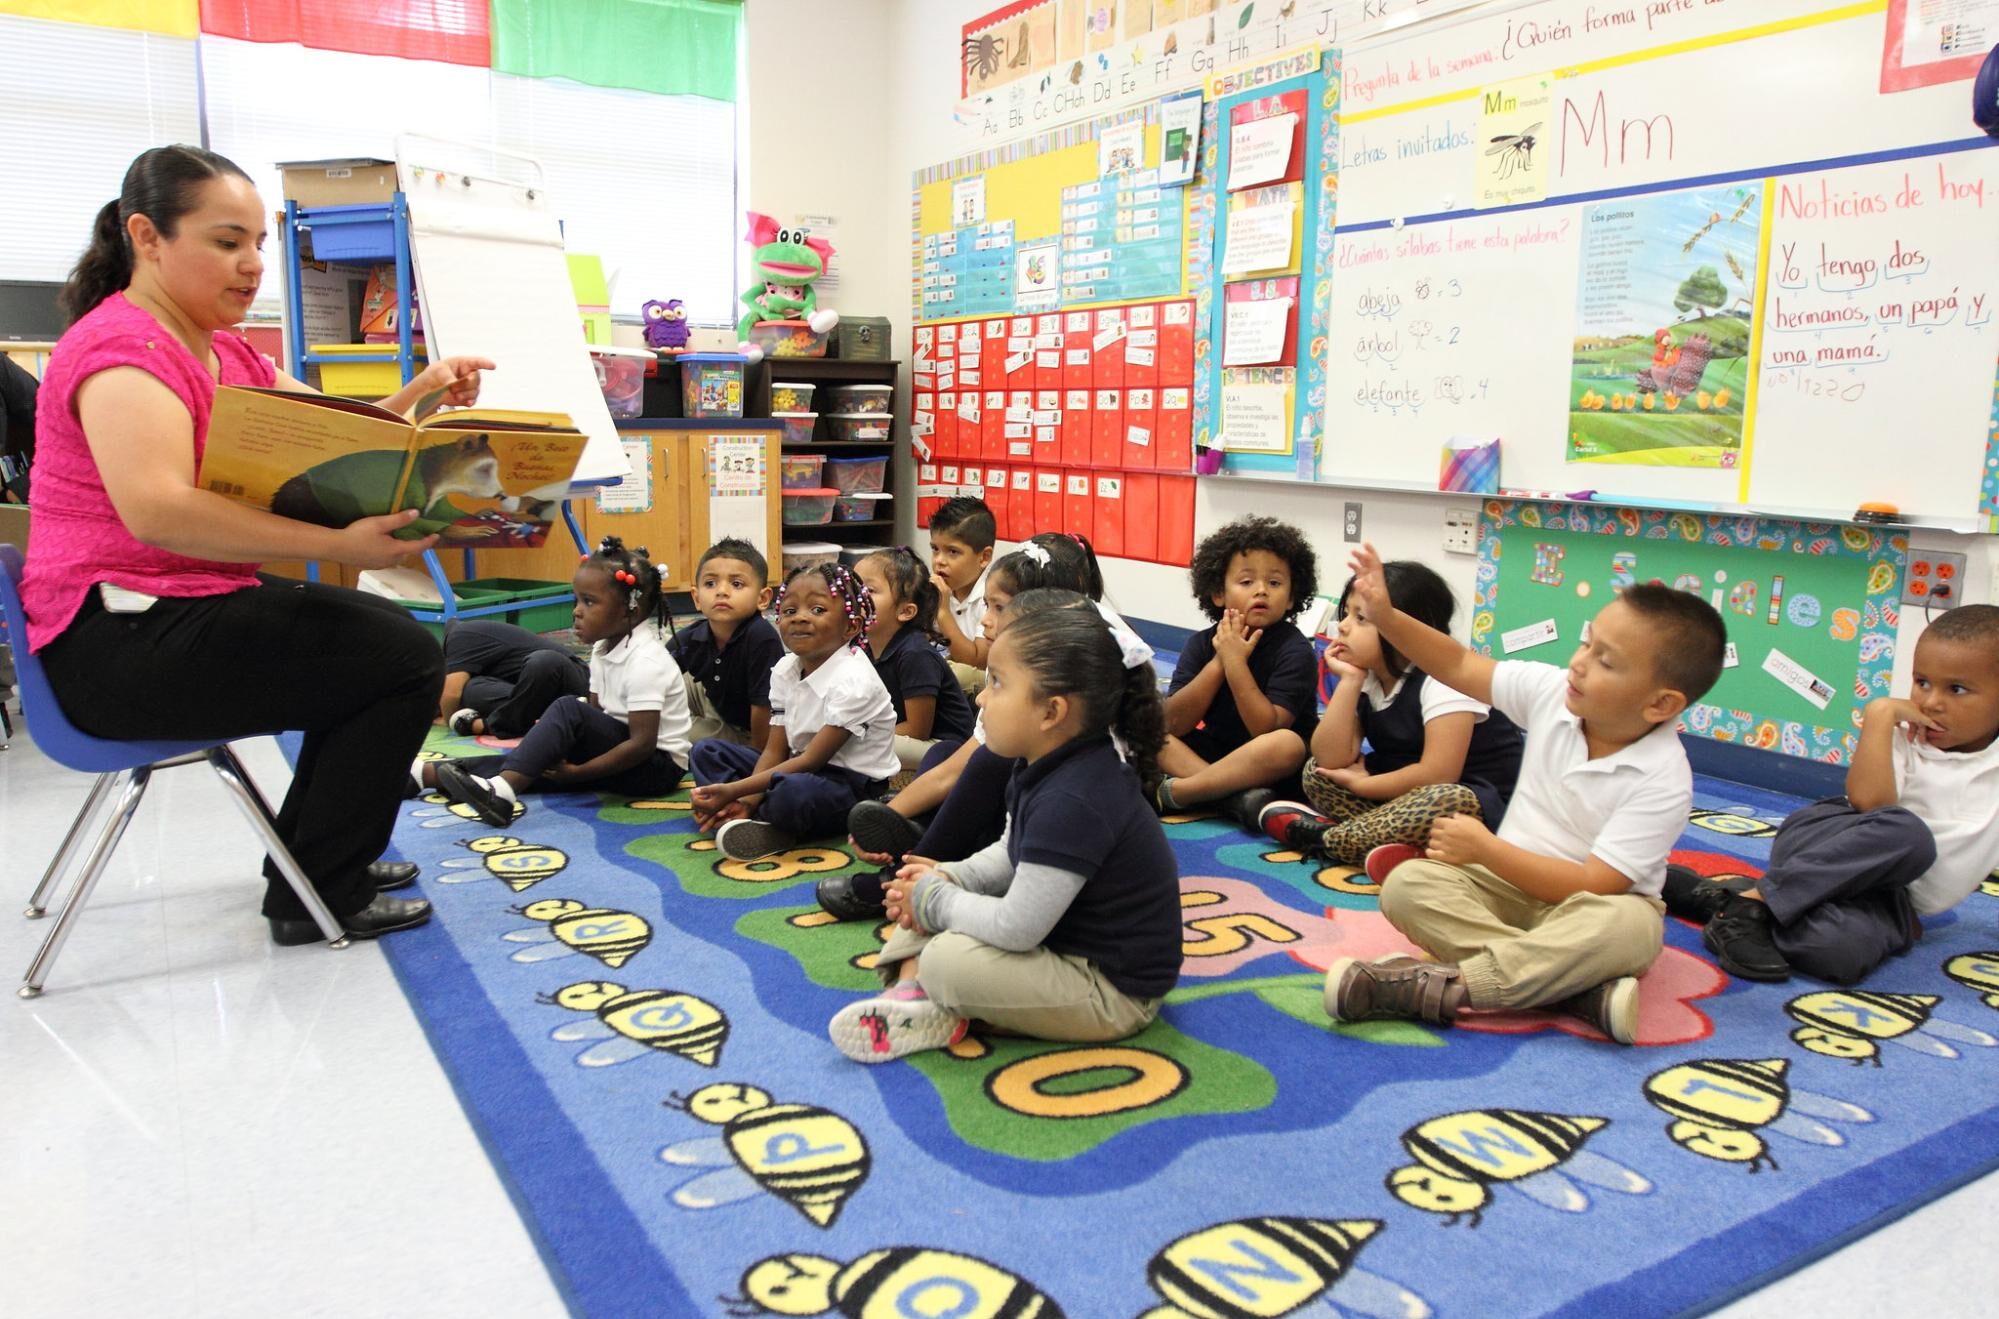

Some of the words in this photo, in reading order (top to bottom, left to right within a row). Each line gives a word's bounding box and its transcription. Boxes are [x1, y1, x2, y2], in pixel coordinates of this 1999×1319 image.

[1584, 6, 1636, 33] forma
[1094, 80, 1111, 103] Dd
[1121, 73, 1136, 94] Ee
[1155, 59, 1172, 83] Ff
[1229, 37, 1248, 62] Hh
[1317, 8, 1337, 44] Jj
[1212, 51, 1314, 96] OBJECTIVES
[1343, 61, 1400, 101] Pregunta
[1408, 60, 1421, 82] de
[1428, 56, 1440, 79] la
[1485, 90, 1517, 115] Mm
[1342, 128, 1388, 169] Letras
[1560, 89, 1674, 177] Mm
[1245, 185, 1289, 208] MATH
[1780, 178, 1888, 219] Noticias
[1896, 173, 1924, 209] de
[1484, 226, 1509, 249] esta
[1782, 241, 1801, 283] Yo
[1817, 242, 1876, 287] tengo
[1889, 239, 1925, 269] dos
[1358, 287, 1401, 314] abeja
[1449, 279, 1462, 297] 3
[1776, 297, 1869, 329] hermanos,
[1880, 302, 1902, 319] un
[1911, 287, 1959, 324] papá
[1357, 329, 1399, 353] árbol
[1449, 327, 1461, 345] 2
[1773, 350, 1808, 363] una
[1227, 368, 1295, 384] SCIENCE
[1357, 380, 1422, 401] elefante
[1479, 378, 1489, 400] 4
[1610, 552, 1861, 641] Sciales
[1771, 658, 1809, 690] amigos
[573, 917, 634, 943] R
[1819, 999, 1895, 1030] K
[758, 1131, 846, 1165] P
[1189, 1238, 1303, 1302] N
